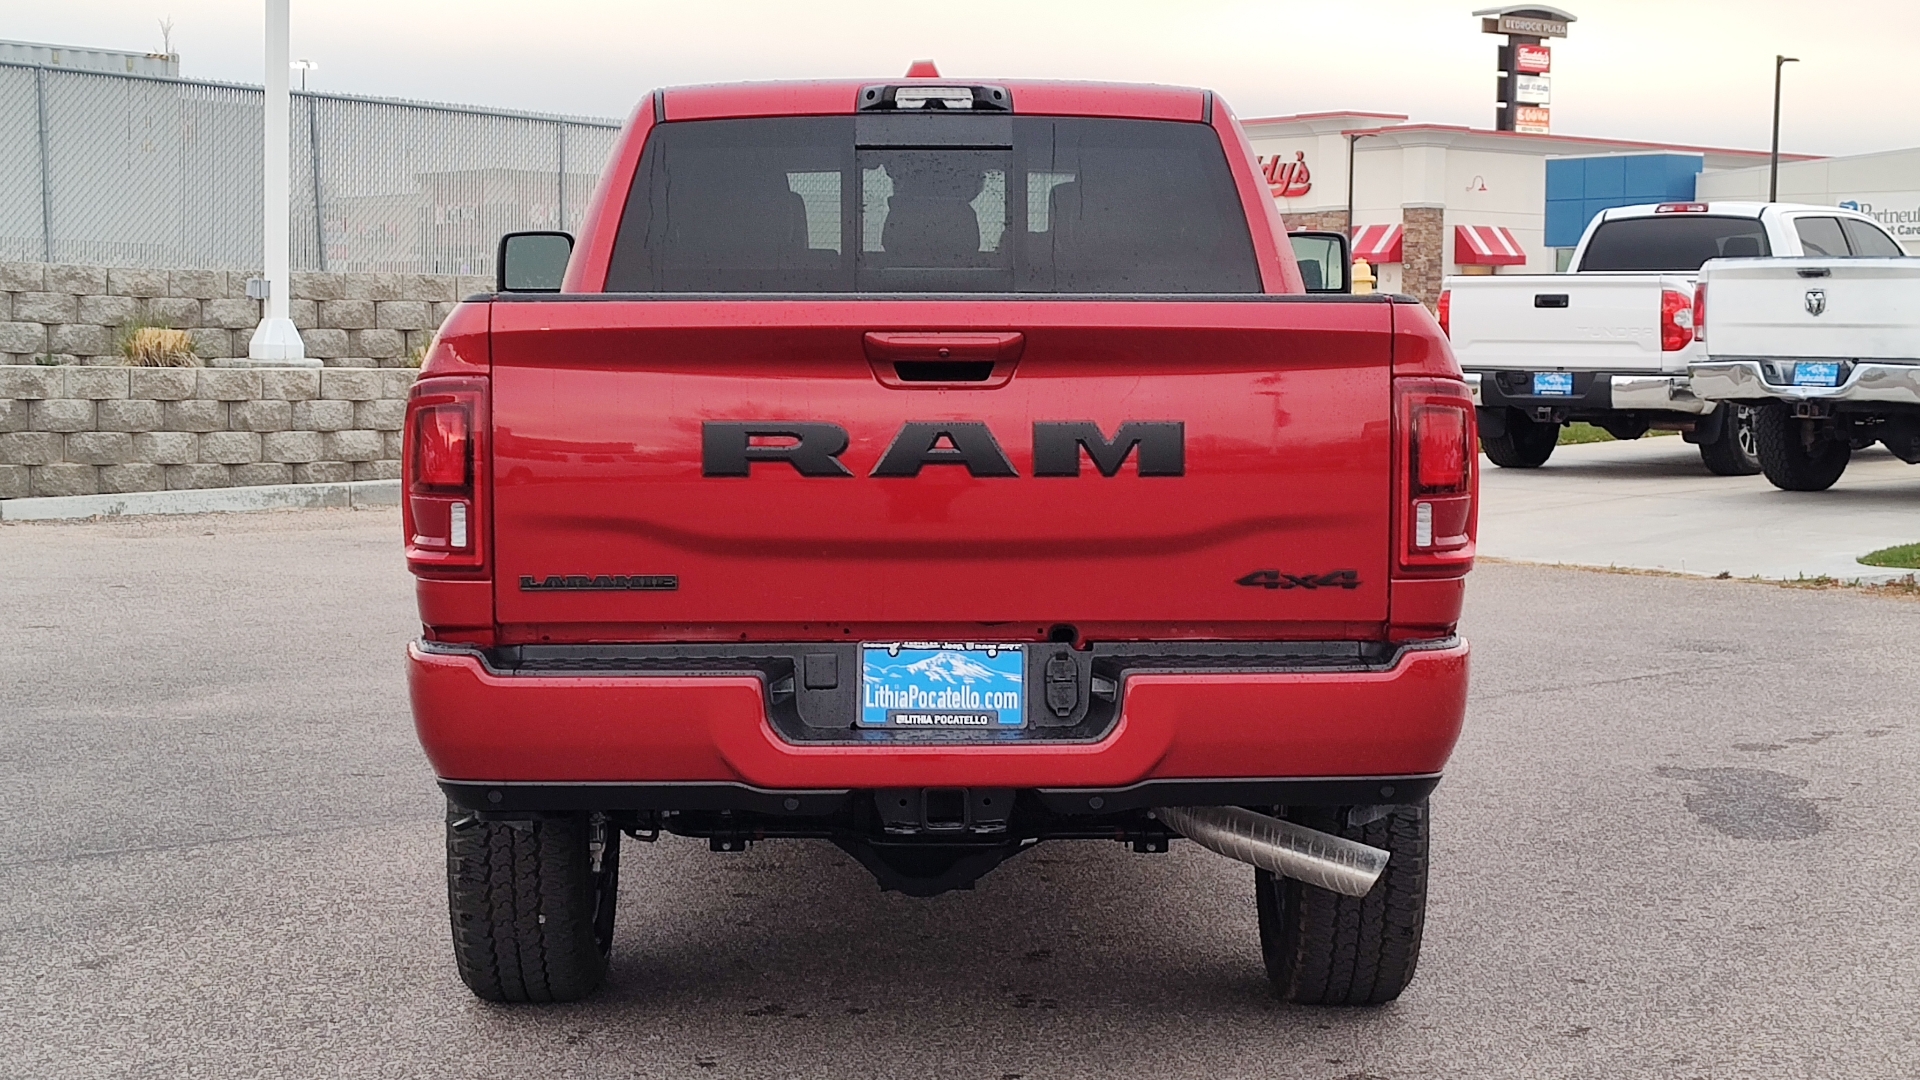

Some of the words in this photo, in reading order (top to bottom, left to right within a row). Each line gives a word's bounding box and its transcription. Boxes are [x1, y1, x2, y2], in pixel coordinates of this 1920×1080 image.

[1505, 19, 1541, 32] BEDROCK
[1543, 23, 1566, 34] PLAZA
[1576, 326, 1654, 339] TUNDRA
[702, 420, 1186, 478] RAM
[519, 575, 678, 591] LARAMIE
[1234, 569, 1361, 590] 4x4
[865, 684, 1018, 709] LithiaPocatello.com
[905, 714, 933, 724] LITHIA
[934, 715, 988, 725] POCATELLO
